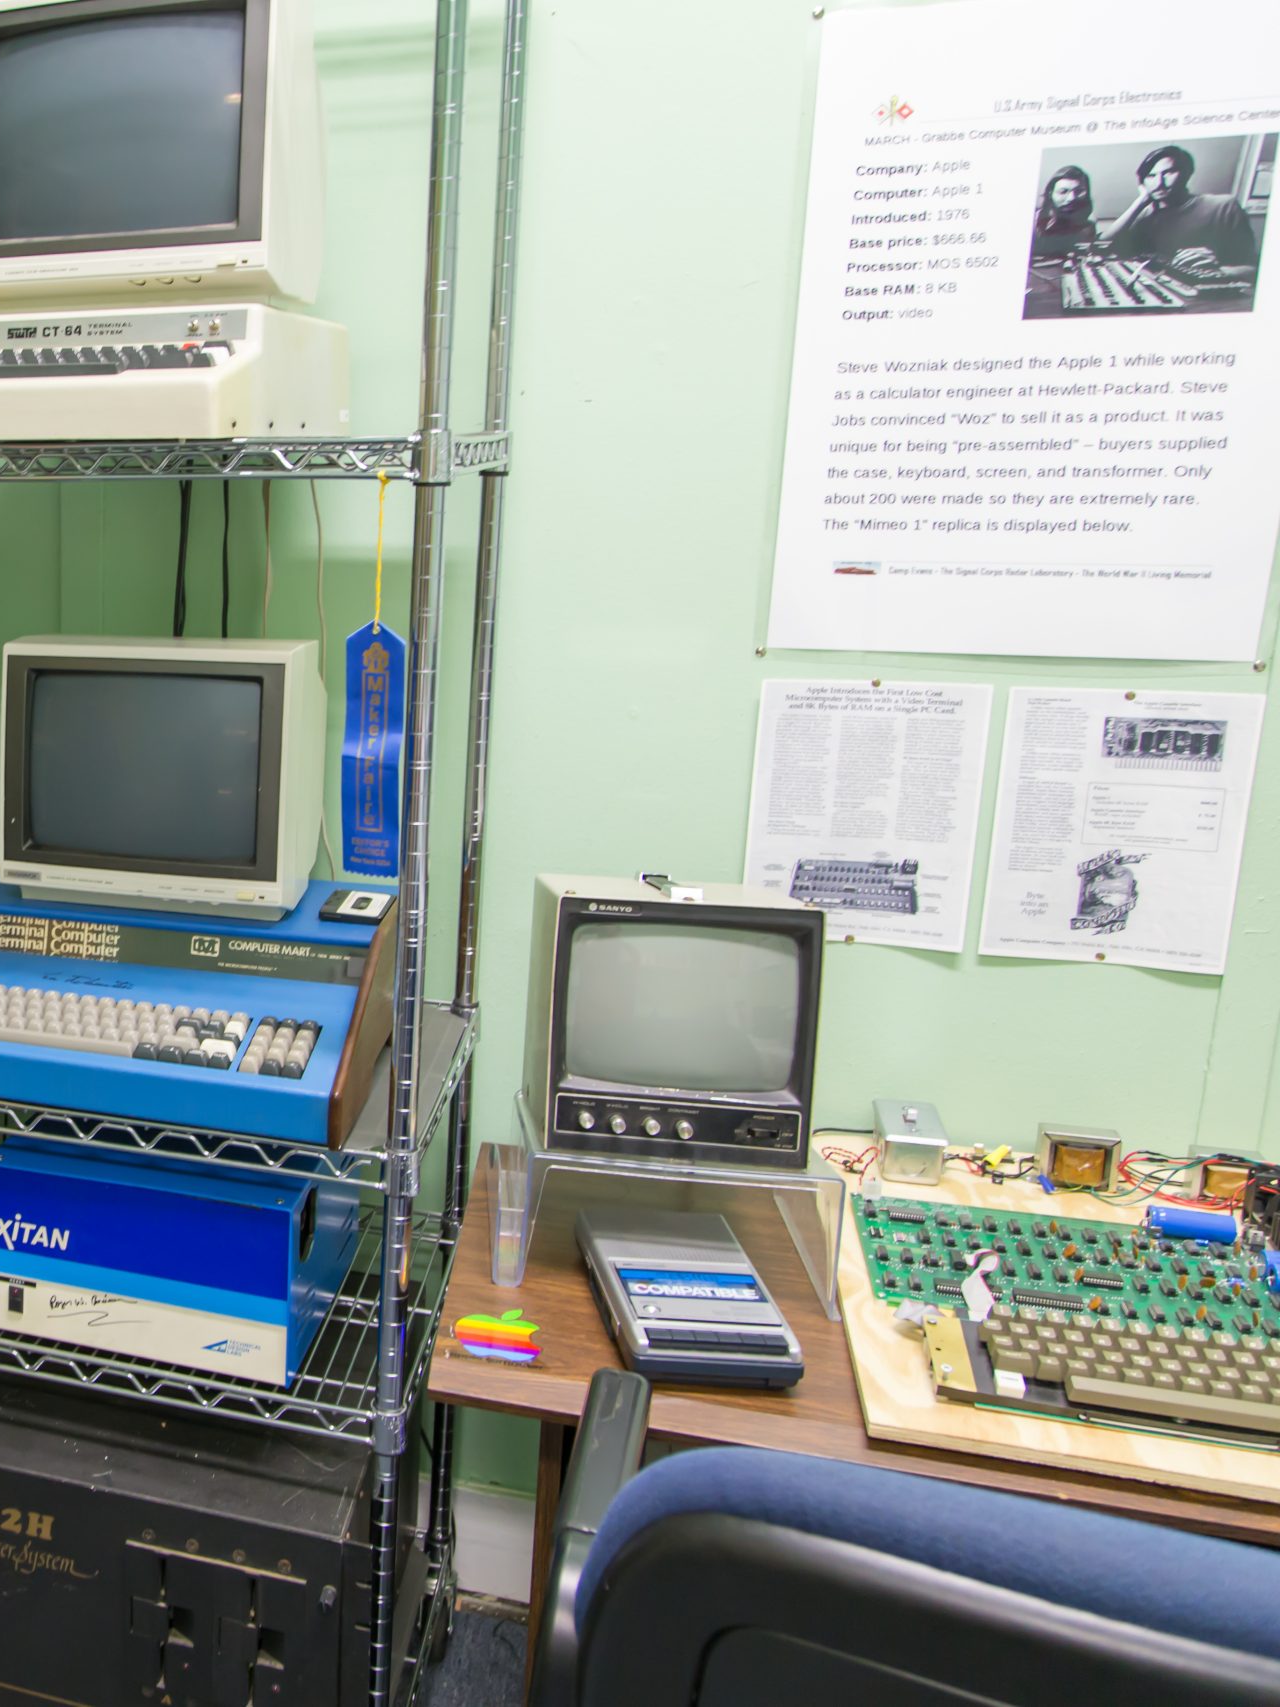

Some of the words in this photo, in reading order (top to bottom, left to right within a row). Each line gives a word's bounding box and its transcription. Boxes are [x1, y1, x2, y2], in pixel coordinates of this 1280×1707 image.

[856, 164, 927, 177] Company:
[932, 160, 970, 173] Apple
[853, 188, 928, 201] Computer:
[932, 185, 970, 198] Apple
[976, 183, 982, 194] 1
[851, 211, 932, 224] Introduced:
[937, 208, 969, 221] 1976
[849, 238, 883, 249] Base
[887, 236, 928, 250] price:
[932, 232, 986, 245] $666.66
[846, 261, 922, 272] Processor:
[927, 258, 960, 269] MOS
[965, 256, 999, 268] 6502
[844, 286, 878, 296] Base
[882, 284, 920, 295] RAM:
[925, 283, 933, 293] 8
[938, 282, 956, 292] KB
[842, 310, 893, 322] Output:
[898, 308, 932, 318] video
[837, 362, 878, 373] Steve
[884, 359, 948, 372] Wozniak
[952, 357, 1024, 373] designed
[1028, 356, 1052, 369] the
[1056, 355, 1102, 370] Apple
[1109, 355, 1117, 367] 1
[1123, 353, 1165, 366] while
[1170, 352, 1236, 367] working
[834, 390, 851, 400] as
[856, 390, 864, 400] a
[869, 387, 942, 399] calculator
[946, 385, 1013, 400] engineer
[1017, 385, 1034, 397] at
[1038, 382, 1173, 396] Hewlett-Packard.
[1180, 381, 1228, 393] Steve
[832, 414, 866, 426] Jobs
[870, 413, 946, 425] convinced
[1001, 412, 1015, 424] to
[1020, 411, 1047, 424] sell
[1051, 411, 1061, 423] it
[1064, 413, 1083, 423] as
[1088, 413, 1098, 423] a
[1103, 410, 1168, 425] product.
[1176, 410, 1186, 421] It
[1190, 411, 1224, 421] was
[829, 440, 877, 454] unique
[882, 440, 902, 452] for
[906, 440, 947, 454] being
[1098, 438, 1152, 452] buyers
[1158, 436, 1228, 451] supplied
[827, 466, 848, 478] the
[853, 468, 892, 479] case,
[897, 466, 970, 480] keyboard,
[976, 468, 1031, 479] screen,
[1036, 465, 1066, 477] and
[1072, 465, 1167, 477] transformer.
[1174, 465, 1212, 480] Only
[824, 493, 865, 504] about
[868, 493, 896, 504] 200
[900, 495, 936, 504] were
[941, 492, 984, 504] made
[988, 495, 1006, 504] so
[1012, 492, 1044, 507] they
[1049, 495, 1074, 504] are
[1079, 493, 1158, 507] extremely
[1162, 495, 1199, 504] rare.
[823, 518, 848, 530] The
[932, 518, 980, 532] replica
[986, 519, 998, 531] is
[1003, 519, 1077, 534] displayed
[1082, 519, 1132, 531] below.
[599, 904, 633, 913] SANYO
[51, 925, 121, 945] Computer
[50, 937, 120, 958] Computer
[228, 940, 281, 955] COMPUTER
[281, 944, 311, 957] MART
[634, 1284, 760, 1300] COMPATIBLE
[12, 1540, 99, 1578] System
